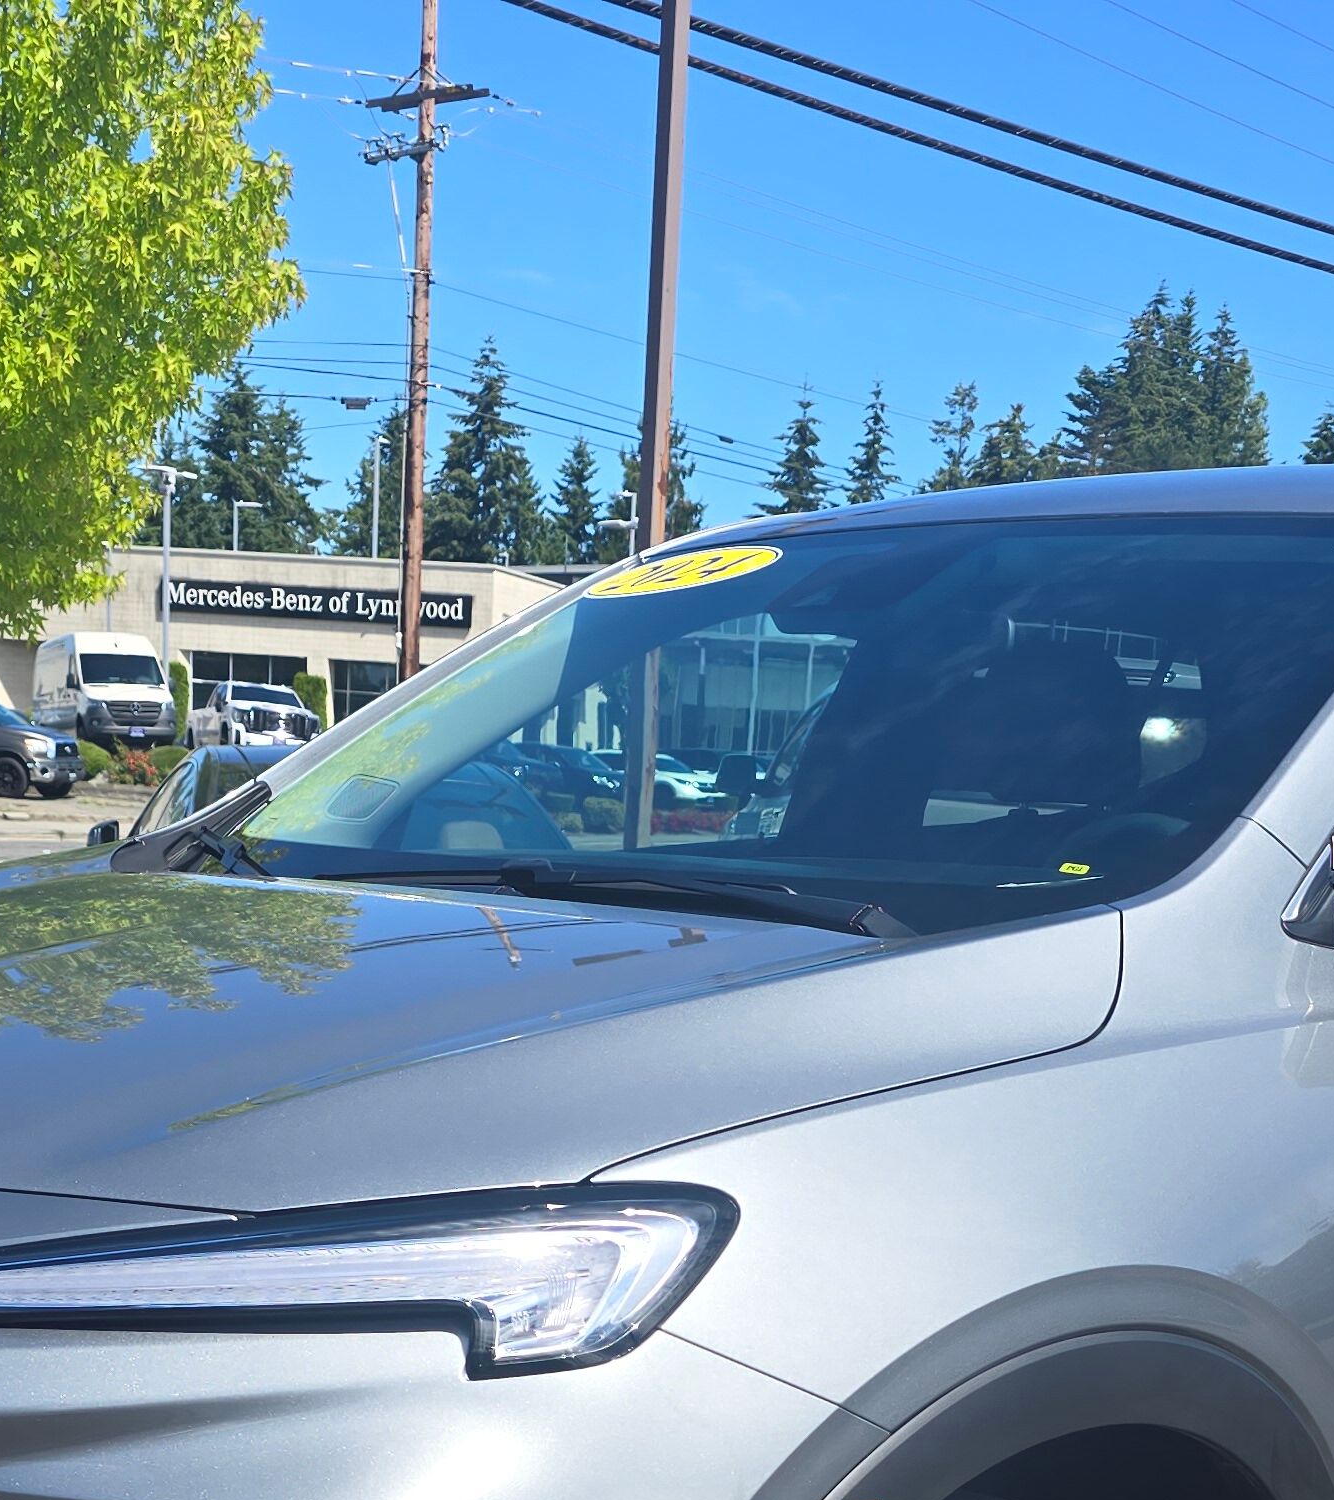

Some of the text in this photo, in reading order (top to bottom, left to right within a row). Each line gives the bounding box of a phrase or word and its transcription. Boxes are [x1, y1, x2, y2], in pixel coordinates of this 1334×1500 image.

[598, 552, 764, 593] 2024
[167, 582, 324, 613] Mercedes-Benz
[329, 592, 351, 614] of
